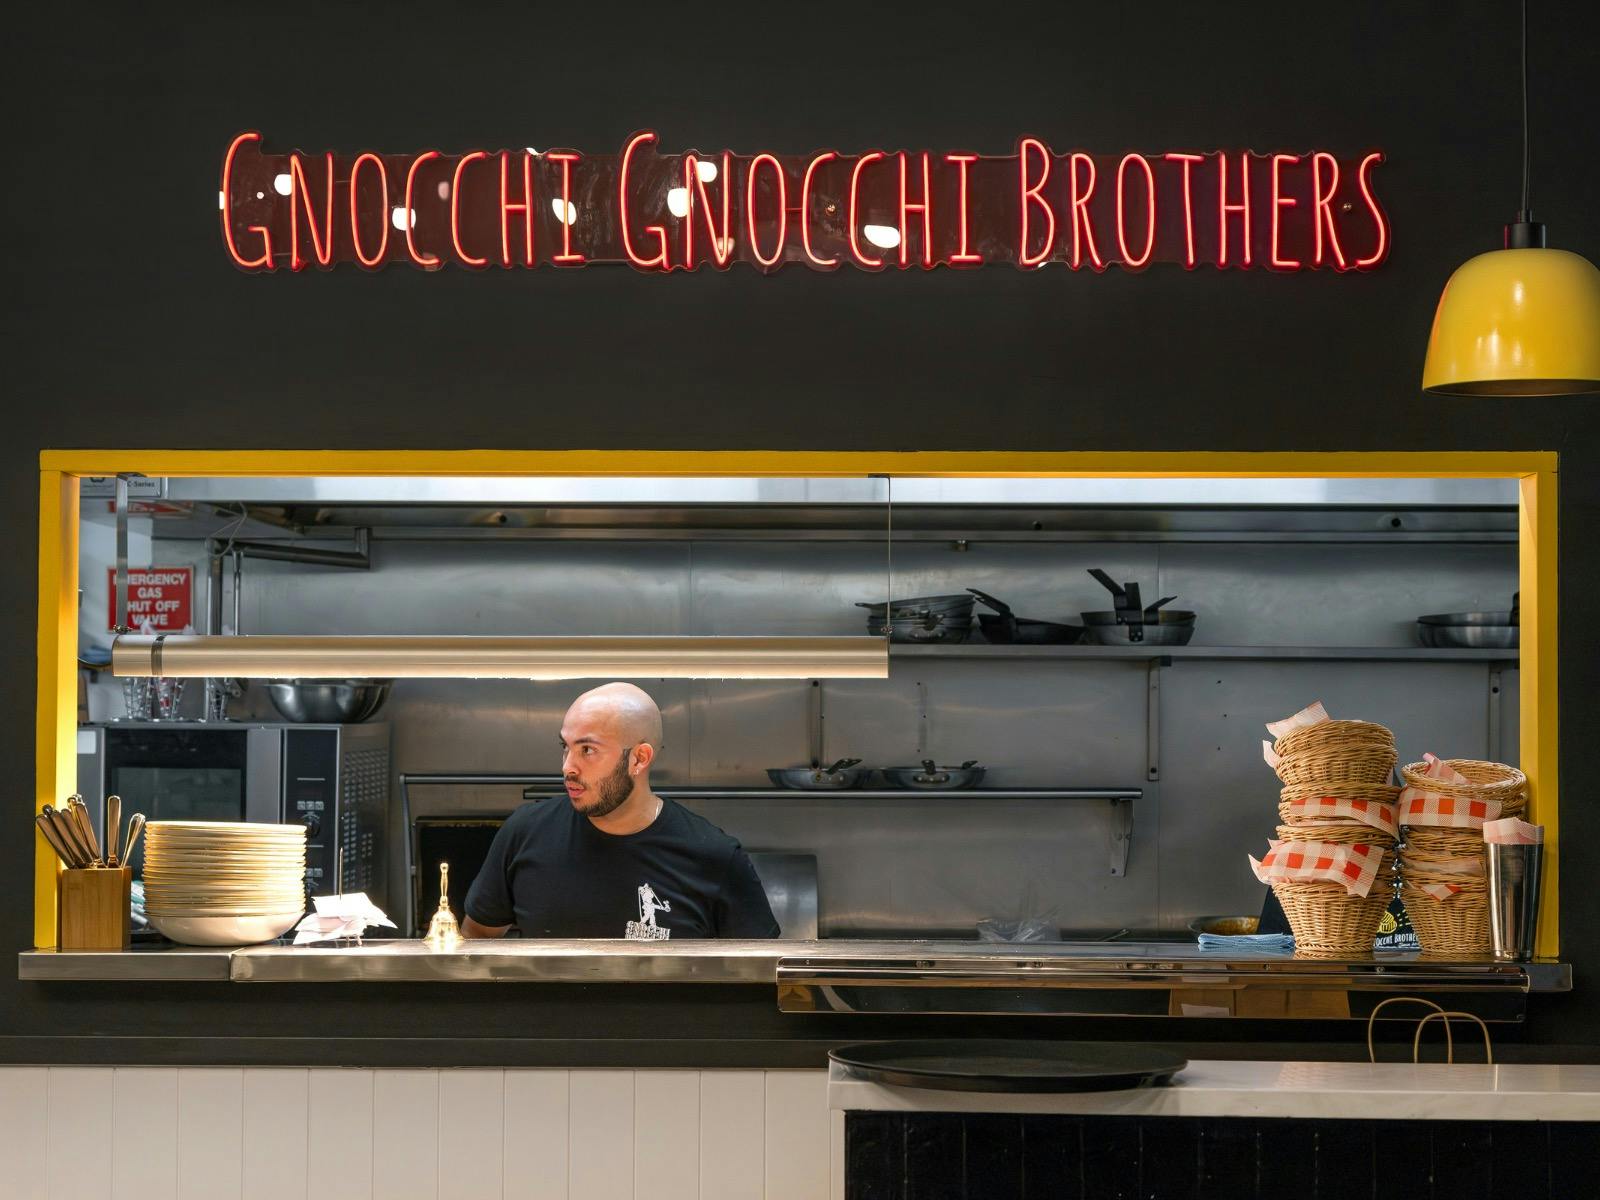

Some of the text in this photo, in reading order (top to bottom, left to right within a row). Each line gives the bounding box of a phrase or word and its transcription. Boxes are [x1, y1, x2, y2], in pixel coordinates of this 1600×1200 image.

[222, 131, 1386, 270] GNOCCHI GNOCCHI BROTHERS
[137, 587, 163, 599] GAS
[127, 600, 180, 613] HUT OFF
